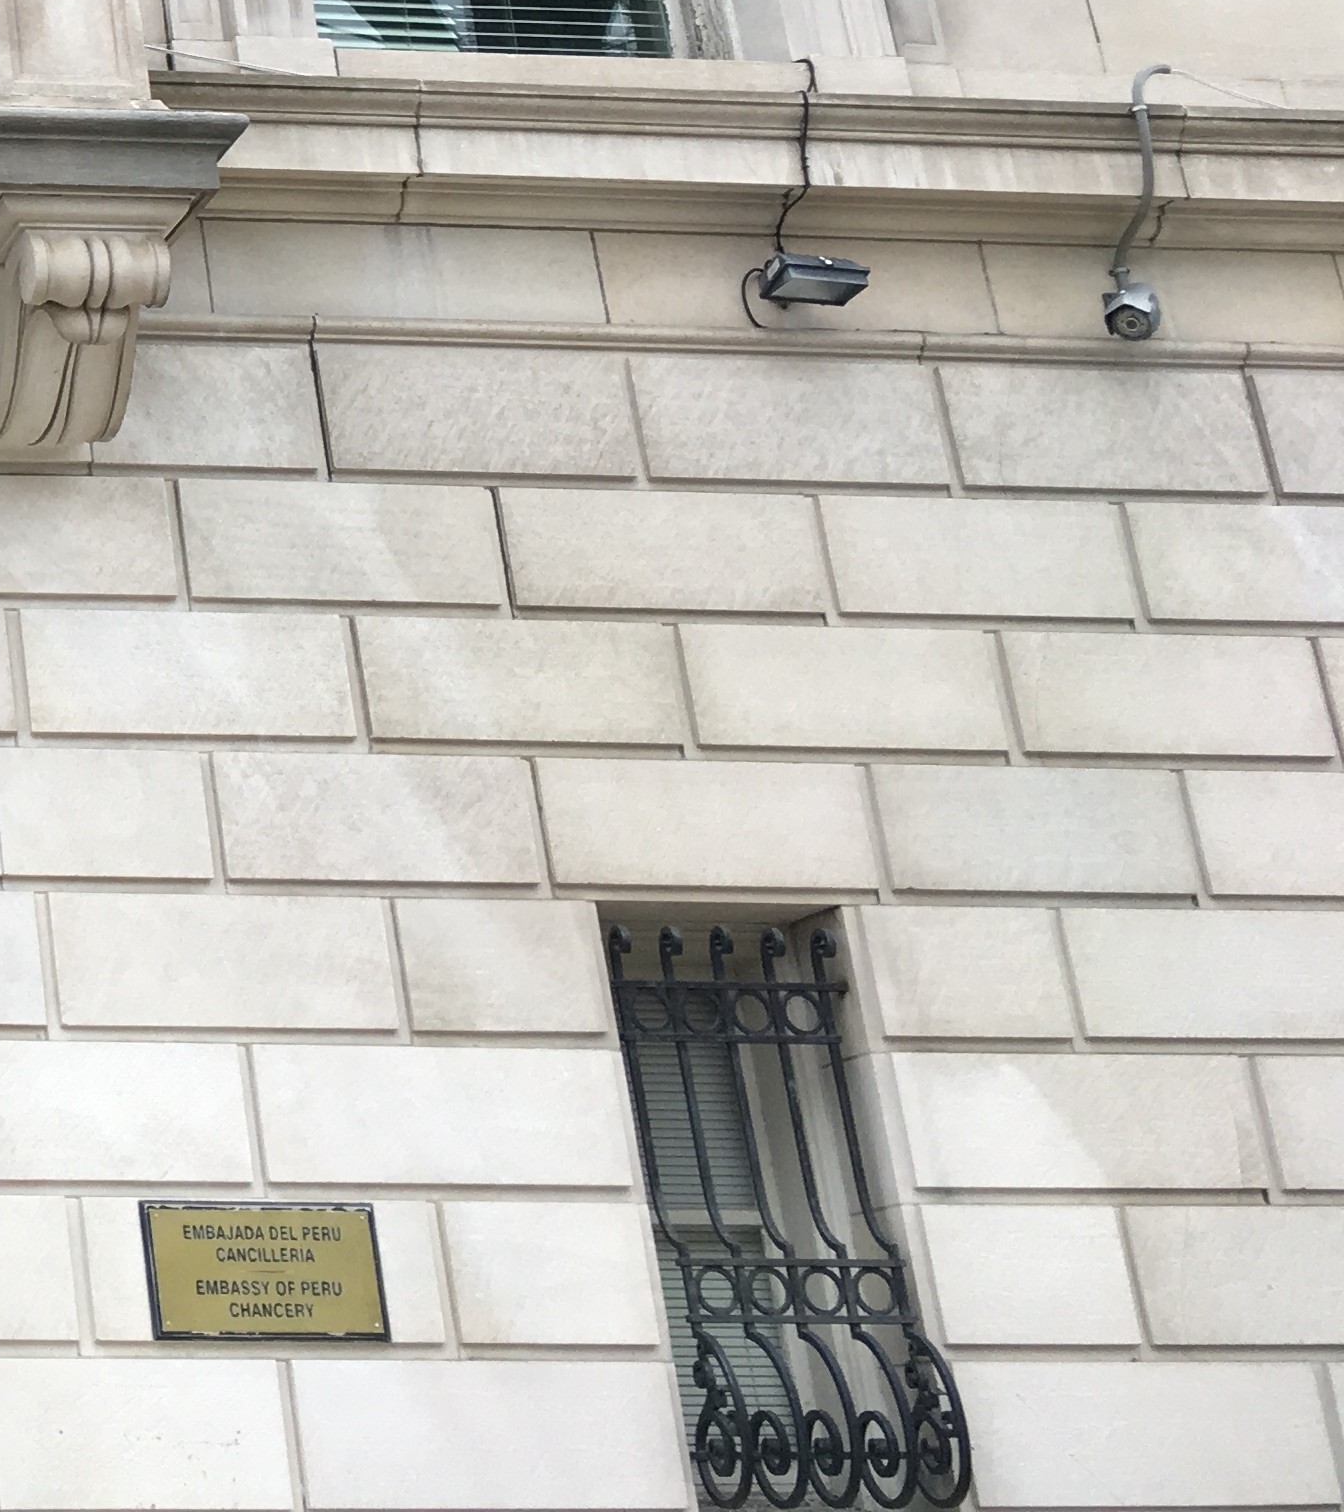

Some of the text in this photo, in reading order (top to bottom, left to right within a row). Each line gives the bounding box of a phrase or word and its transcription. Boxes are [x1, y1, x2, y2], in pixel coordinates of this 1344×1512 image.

[182, 1224, 342, 1242] EMBAJADA DEL PERU
[195, 1279, 343, 1296] EMBASSY OF PERU
[229, 1302, 314, 1318] CHANCERY
